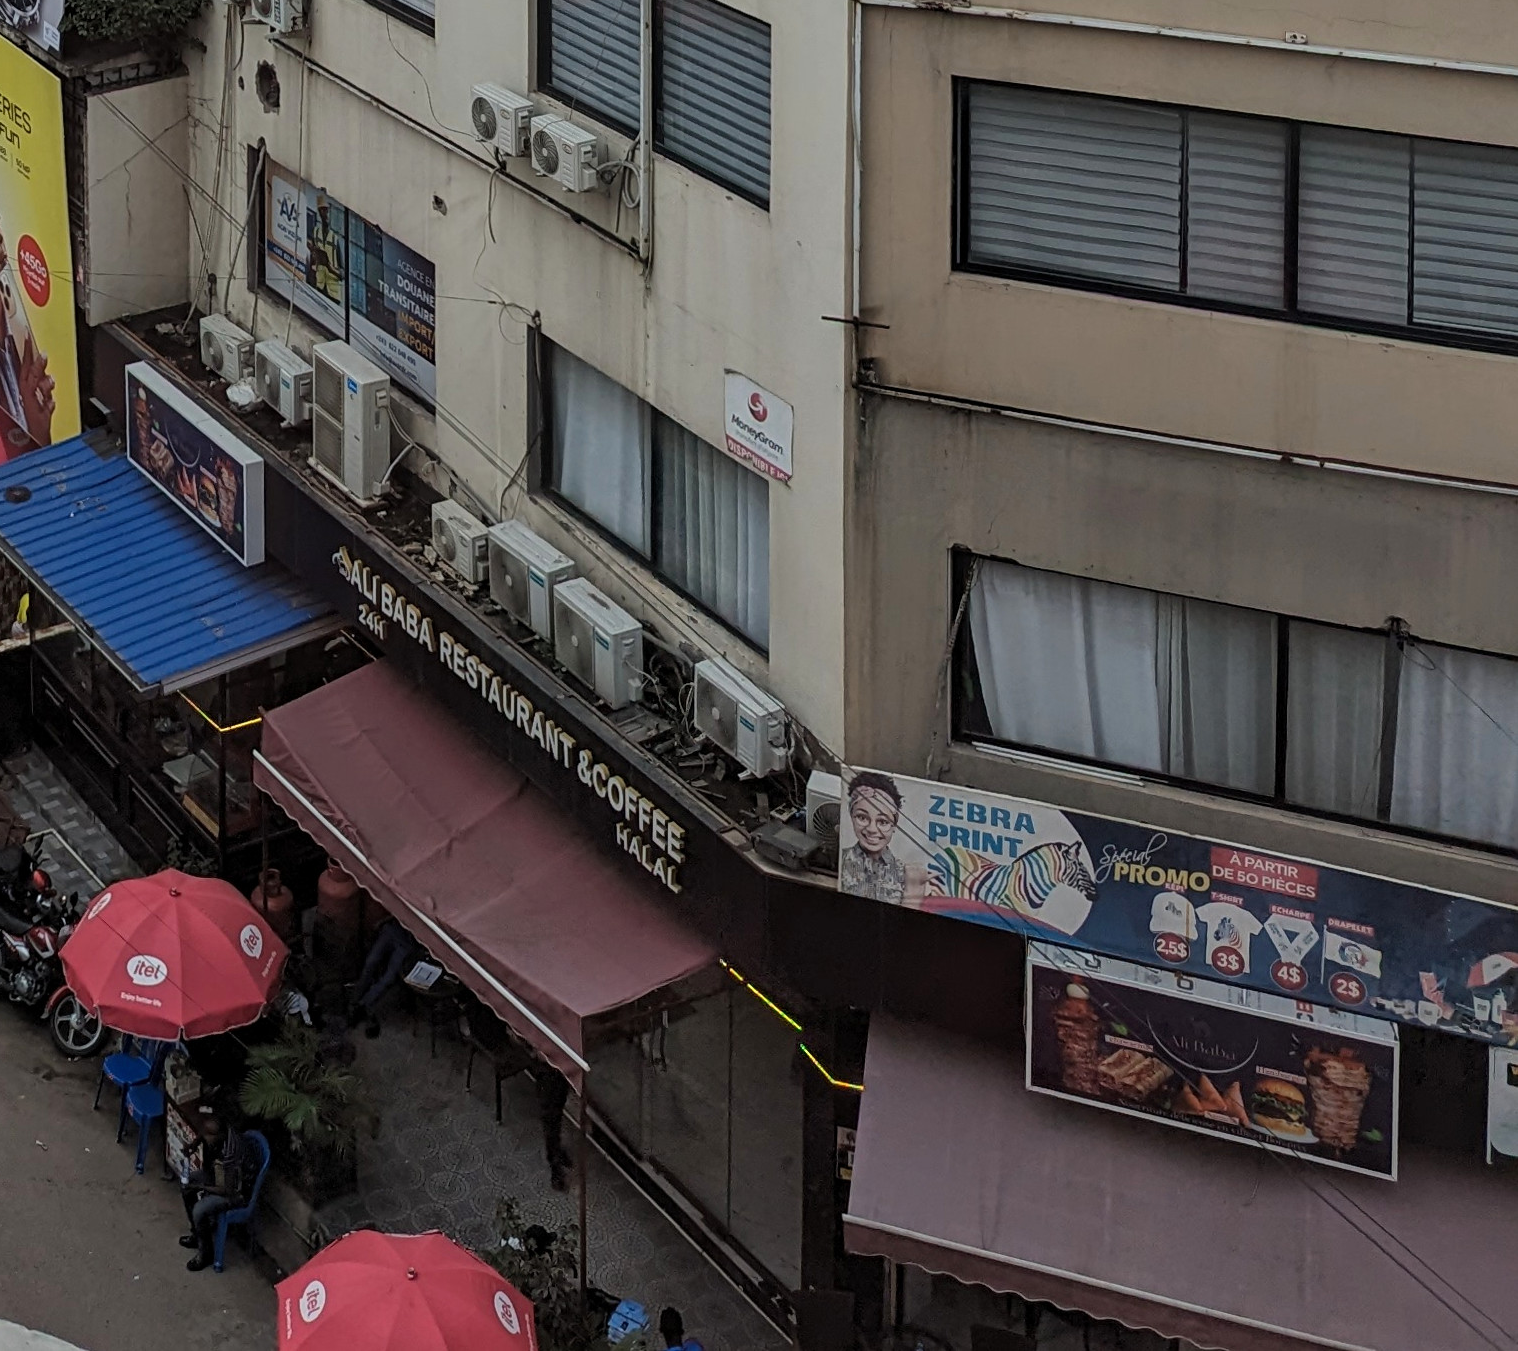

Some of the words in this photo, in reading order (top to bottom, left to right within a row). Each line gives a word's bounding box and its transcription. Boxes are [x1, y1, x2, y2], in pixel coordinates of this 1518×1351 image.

[19, 249, 48, 279] +45Go
[397, 259, 424, 283] AGENCE
[425, 275, 435, 289] EN
[377, 279, 435, 327] TRANSITAIRE
[397, 274, 435, 308] DOUANE
[397, 328, 433, 360] EXPORT
[731, 413, 784, 455] MoneyGram
[358, 603, 387, 641] 24H
[350, 559, 380, 605] ALI
[381, 582, 436, 653] BABA
[439, 631, 576, 769] RESTAURANT
[928, 794, 1036, 835] ZEBRA
[928, 821, 1023, 859] PRINT
[616, 822, 682, 894] HALAL
[1229, 850, 1241, 866] À
[1244, 856, 1299, 879] PARTIR
[1114, 862, 1211, 892] PROMO
[1212, 864, 1234, 879] DE
[1237, 870, 1258, 885] 50
[1261, 871, 1316, 898] PIÈCES
[244, 928, 260, 954] itel
[1156, 938, 1187, 958] 2,5$
[133, 960, 161, 980] itel
[1216, 952, 1240, 971] 3$
[1278, 965, 1300, 984] 4$
[120, 991, 136, 1003] Enjoy
[1336, 978, 1359, 998] 2$
[1194, 1040, 1237, 1061] Baba
[306, 1288, 321, 1317] itel
[498, 1295, 515, 1330] itel
